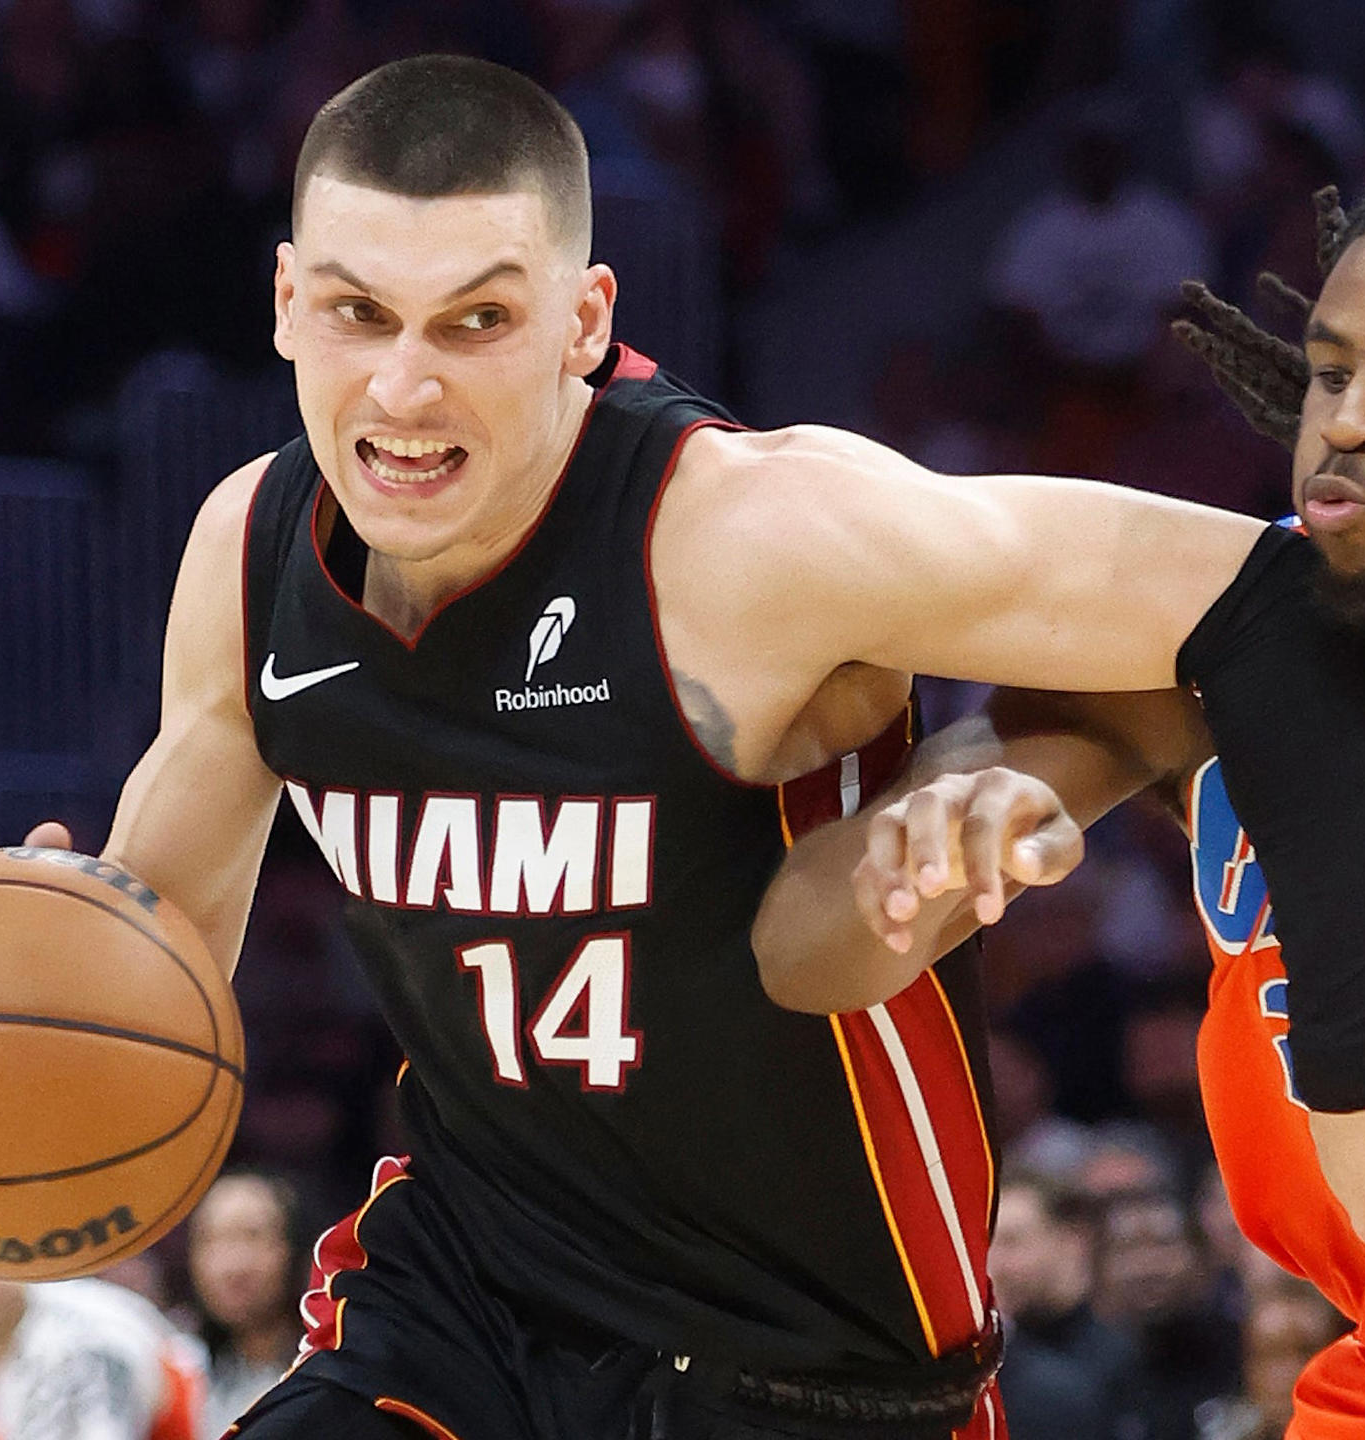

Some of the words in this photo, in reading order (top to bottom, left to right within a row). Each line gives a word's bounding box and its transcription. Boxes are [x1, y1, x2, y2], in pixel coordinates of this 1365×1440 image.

[495, 678, 611, 712] Robinhood
[285, 776, 655, 917] MIAMI
[455, 931, 643, 1093] 14
